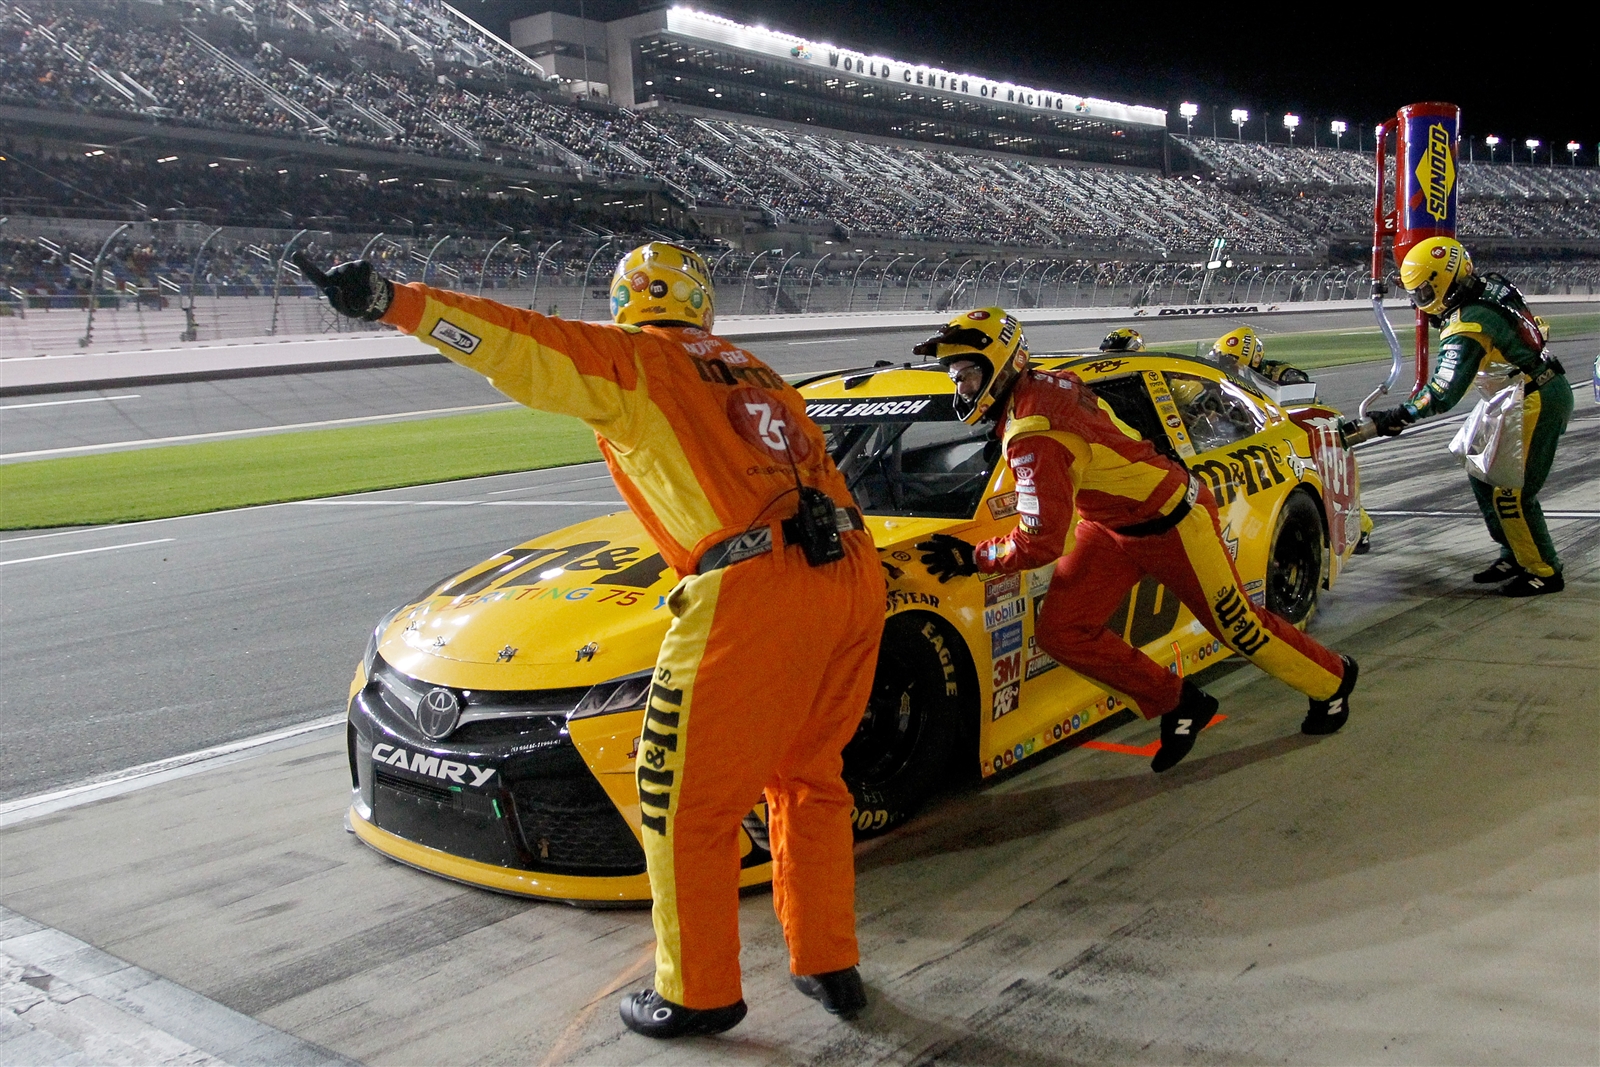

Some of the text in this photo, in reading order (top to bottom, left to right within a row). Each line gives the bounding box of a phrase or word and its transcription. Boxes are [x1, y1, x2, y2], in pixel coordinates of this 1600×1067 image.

[828, 50, 1064, 110] WORLD CENTER OF RACING
[1429, 126, 1449, 218] SUNOCO
[1157, 305, 1260, 316] DAYTONA
[843, 398, 931, 417] BUSCH
[596, 588, 646, 607] 75
[985, 601, 1014, 627] Mobil
[1015, 597, 1026, 614] 1
[921, 621, 958, 697] EAGLE
[993, 650, 1021, 688] 3M
[371, 742, 496, 788] CAMRY
